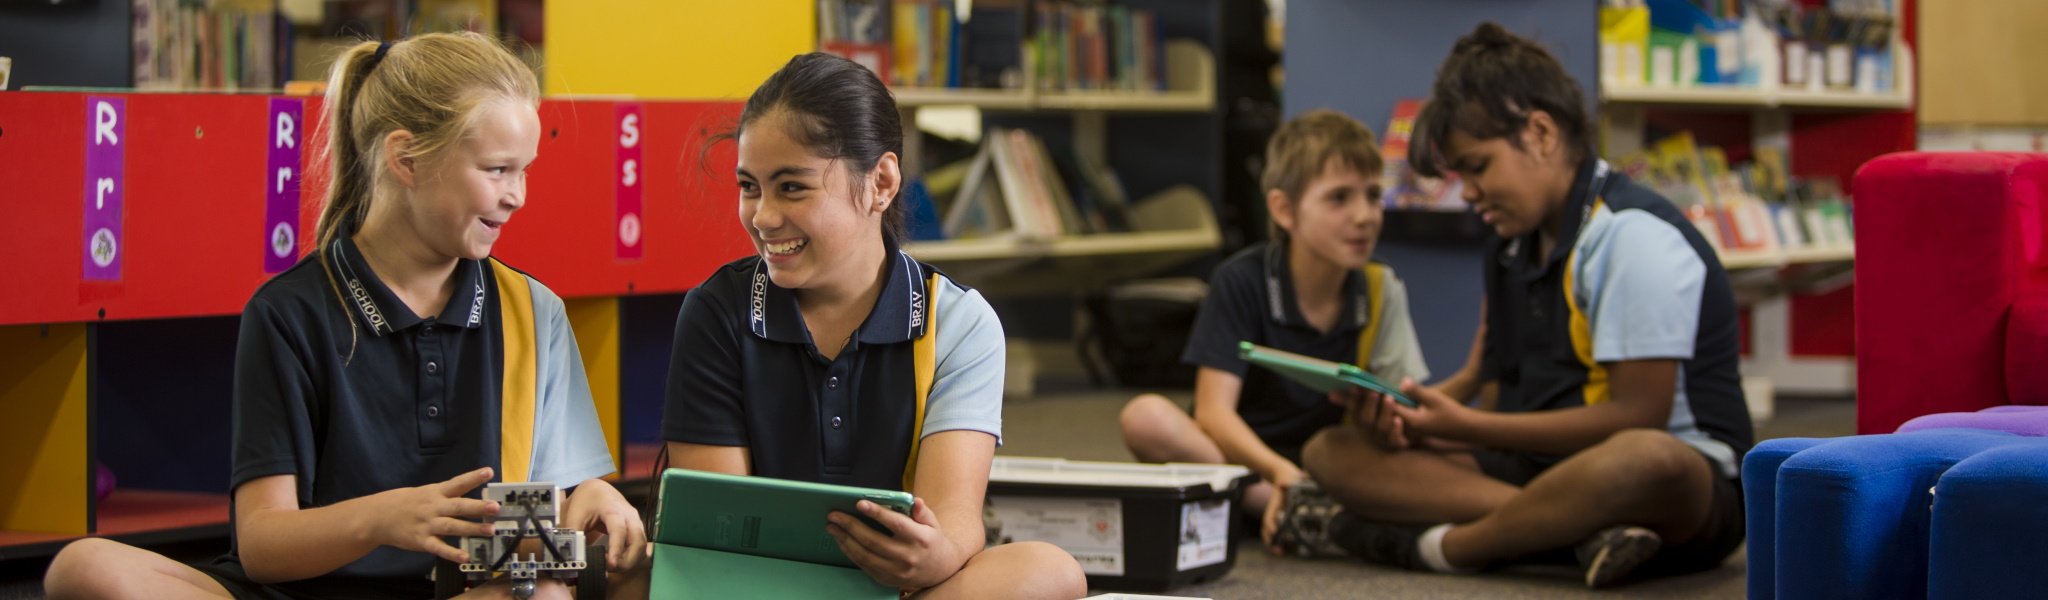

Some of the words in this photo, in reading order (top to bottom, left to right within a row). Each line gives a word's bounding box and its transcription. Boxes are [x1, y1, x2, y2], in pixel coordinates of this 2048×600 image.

[349, 278, 386, 331] SCHOOL
[469, 284, 485, 324] BRAY
[752, 272, 766, 325] SCHOOL
[911, 290, 923, 328] BRAY
